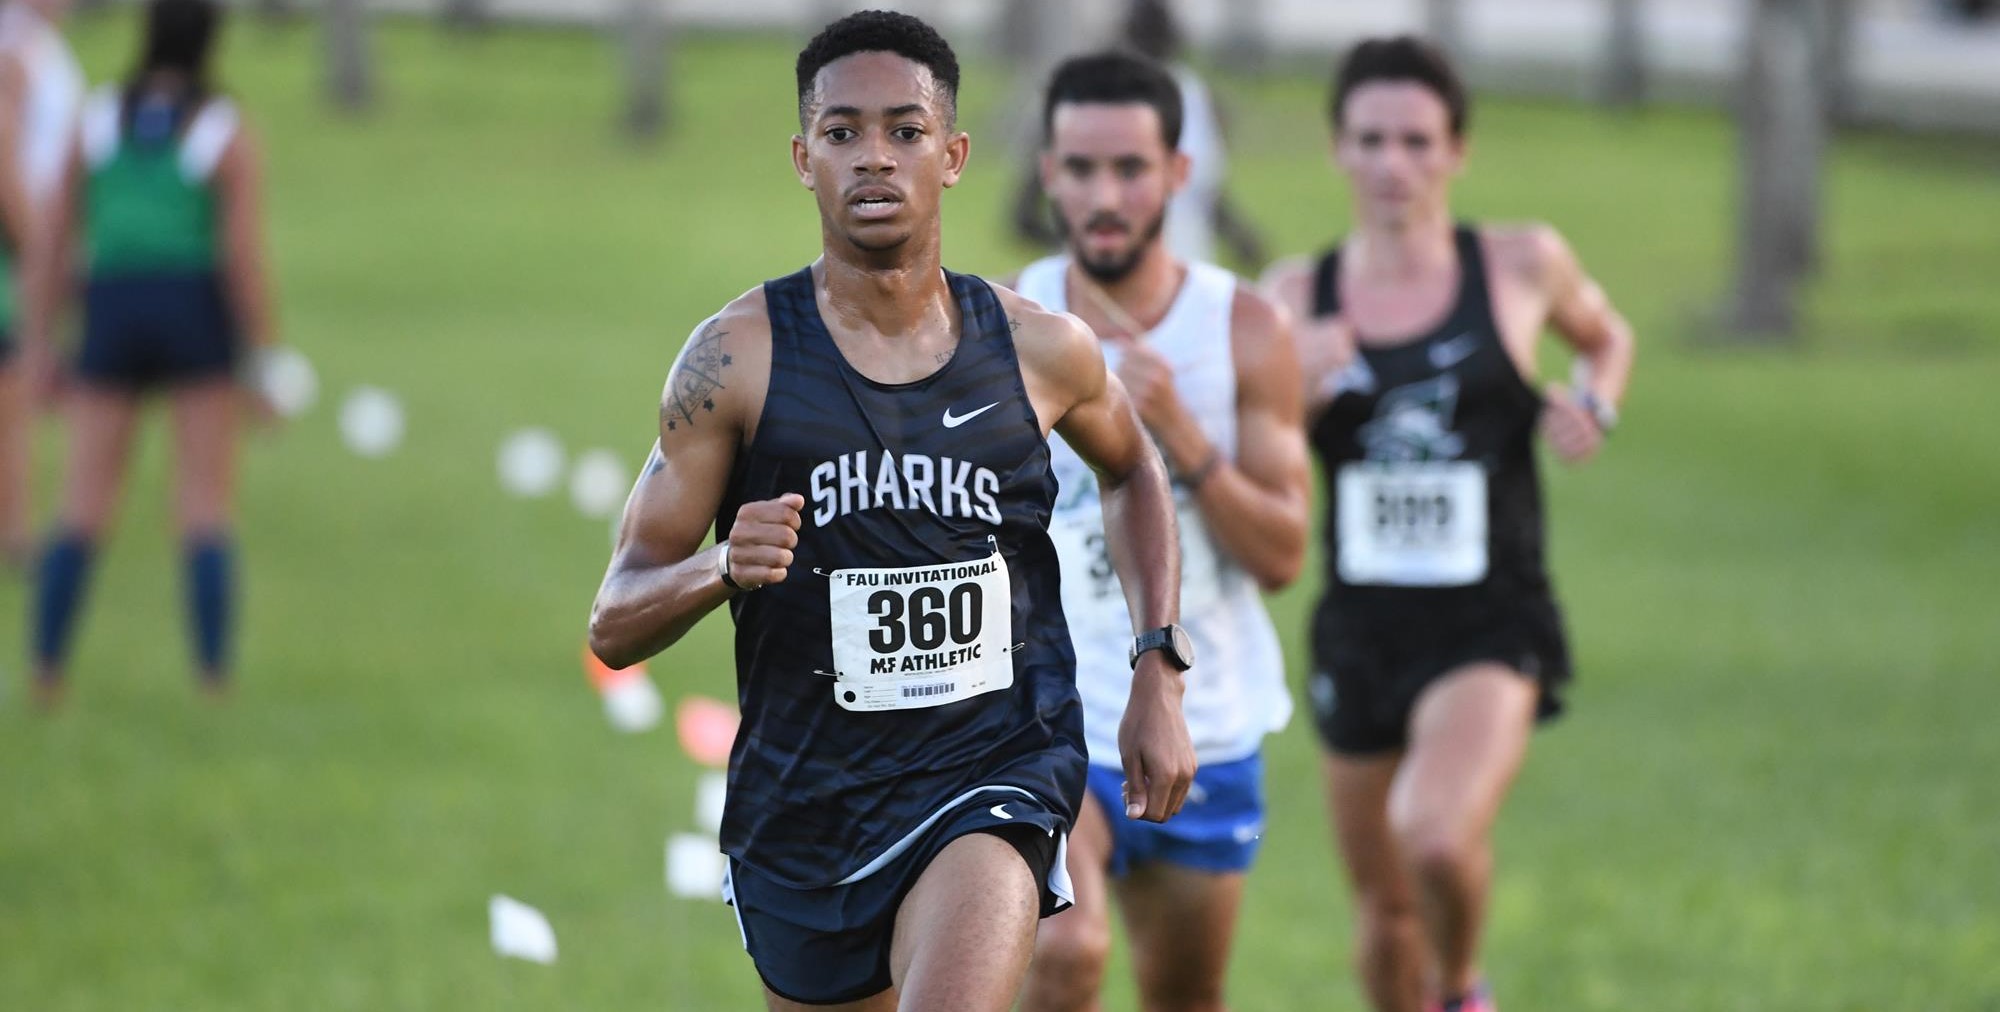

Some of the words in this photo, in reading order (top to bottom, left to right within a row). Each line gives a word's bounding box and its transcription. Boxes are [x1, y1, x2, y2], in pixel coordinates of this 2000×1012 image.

[810, 449, 1002, 528] SHARKS
[846, 573, 879, 586] FAU
[884, 561, 998, 586] INVITATIONAL
[867, 582, 983, 654] 360
[900, 643, 982, 672] ATHLETIC
